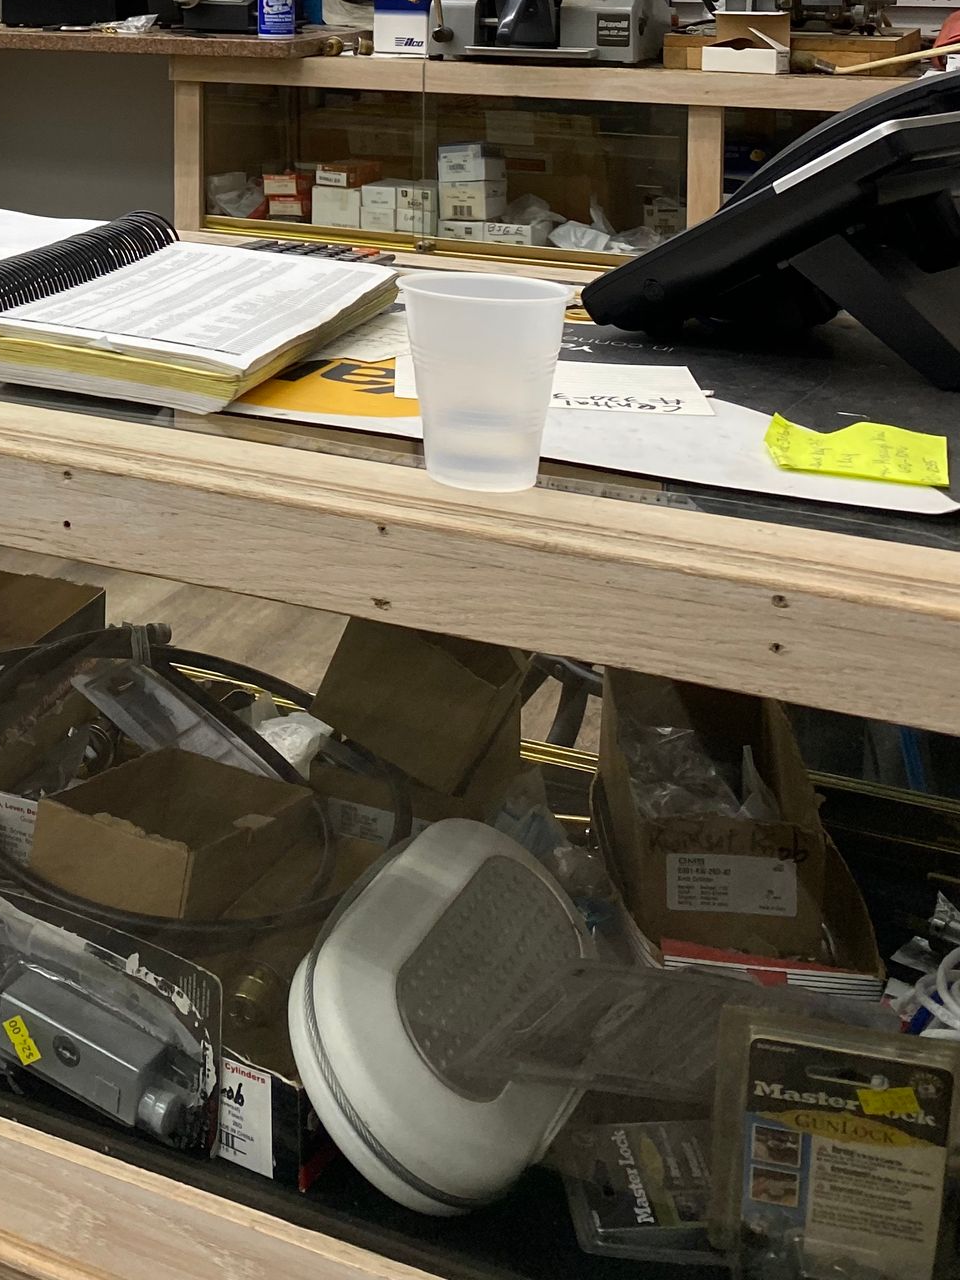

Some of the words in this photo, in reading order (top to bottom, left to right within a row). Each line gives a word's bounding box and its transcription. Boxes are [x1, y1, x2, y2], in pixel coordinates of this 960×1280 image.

[403, 37, 424, 47] ilco
[5, 802, 26, 814] Lever,
[225, 1062, 266, 1084] Cylinders
[753, 1080, 859, 1111] Master
[611, 1130, 635, 1166] Lock
[625, 1167, 655, 1224] Master
